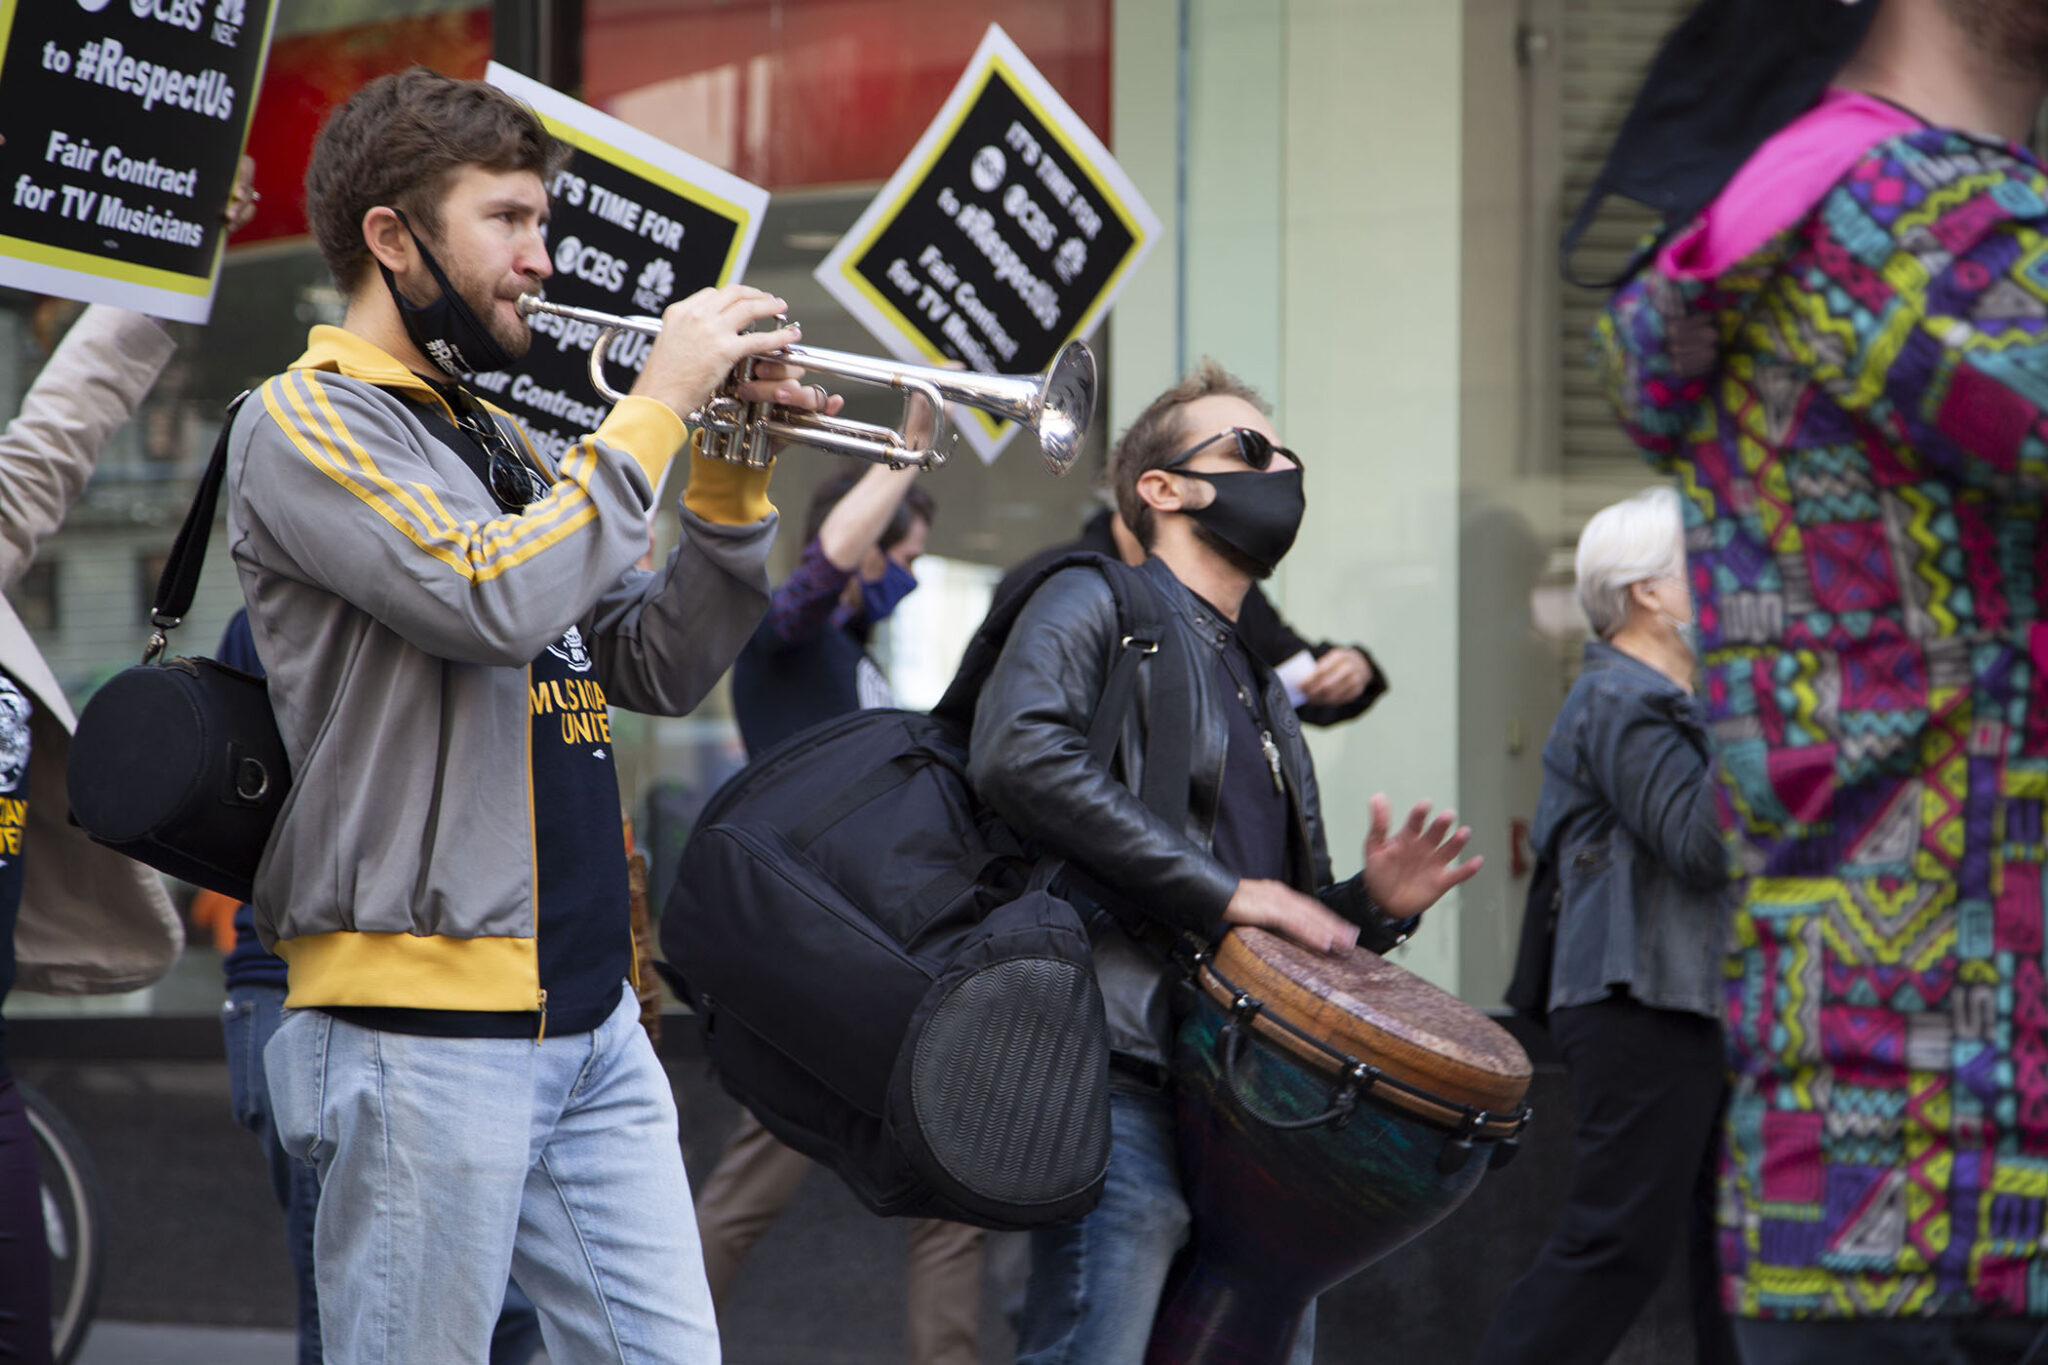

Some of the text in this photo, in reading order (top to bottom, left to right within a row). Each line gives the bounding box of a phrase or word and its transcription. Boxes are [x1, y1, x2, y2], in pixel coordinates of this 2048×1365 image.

[153, 0, 206, 32] CBS
[42, 37, 236, 121] to #RespectUs
[45, 130, 198, 198] Fair Contract
[1035, 152, 1078, 208] TIME
[1067, 194, 1103, 241] FOR
[13, 174, 205, 248] for TV Musicians
[545, 169, 685, 252] T'S TIME FOR
[575, 246, 630, 293] CBS
[937, 186, 961, 217] to
[955, 203, 1061, 331] #RespectUs
[886, 258, 998, 373] for TV Musici
[918, 244, 1019, 363] Fair Contract
[462, 369, 606, 431] air Contract
[561, 711, 611, 745] UNITE
